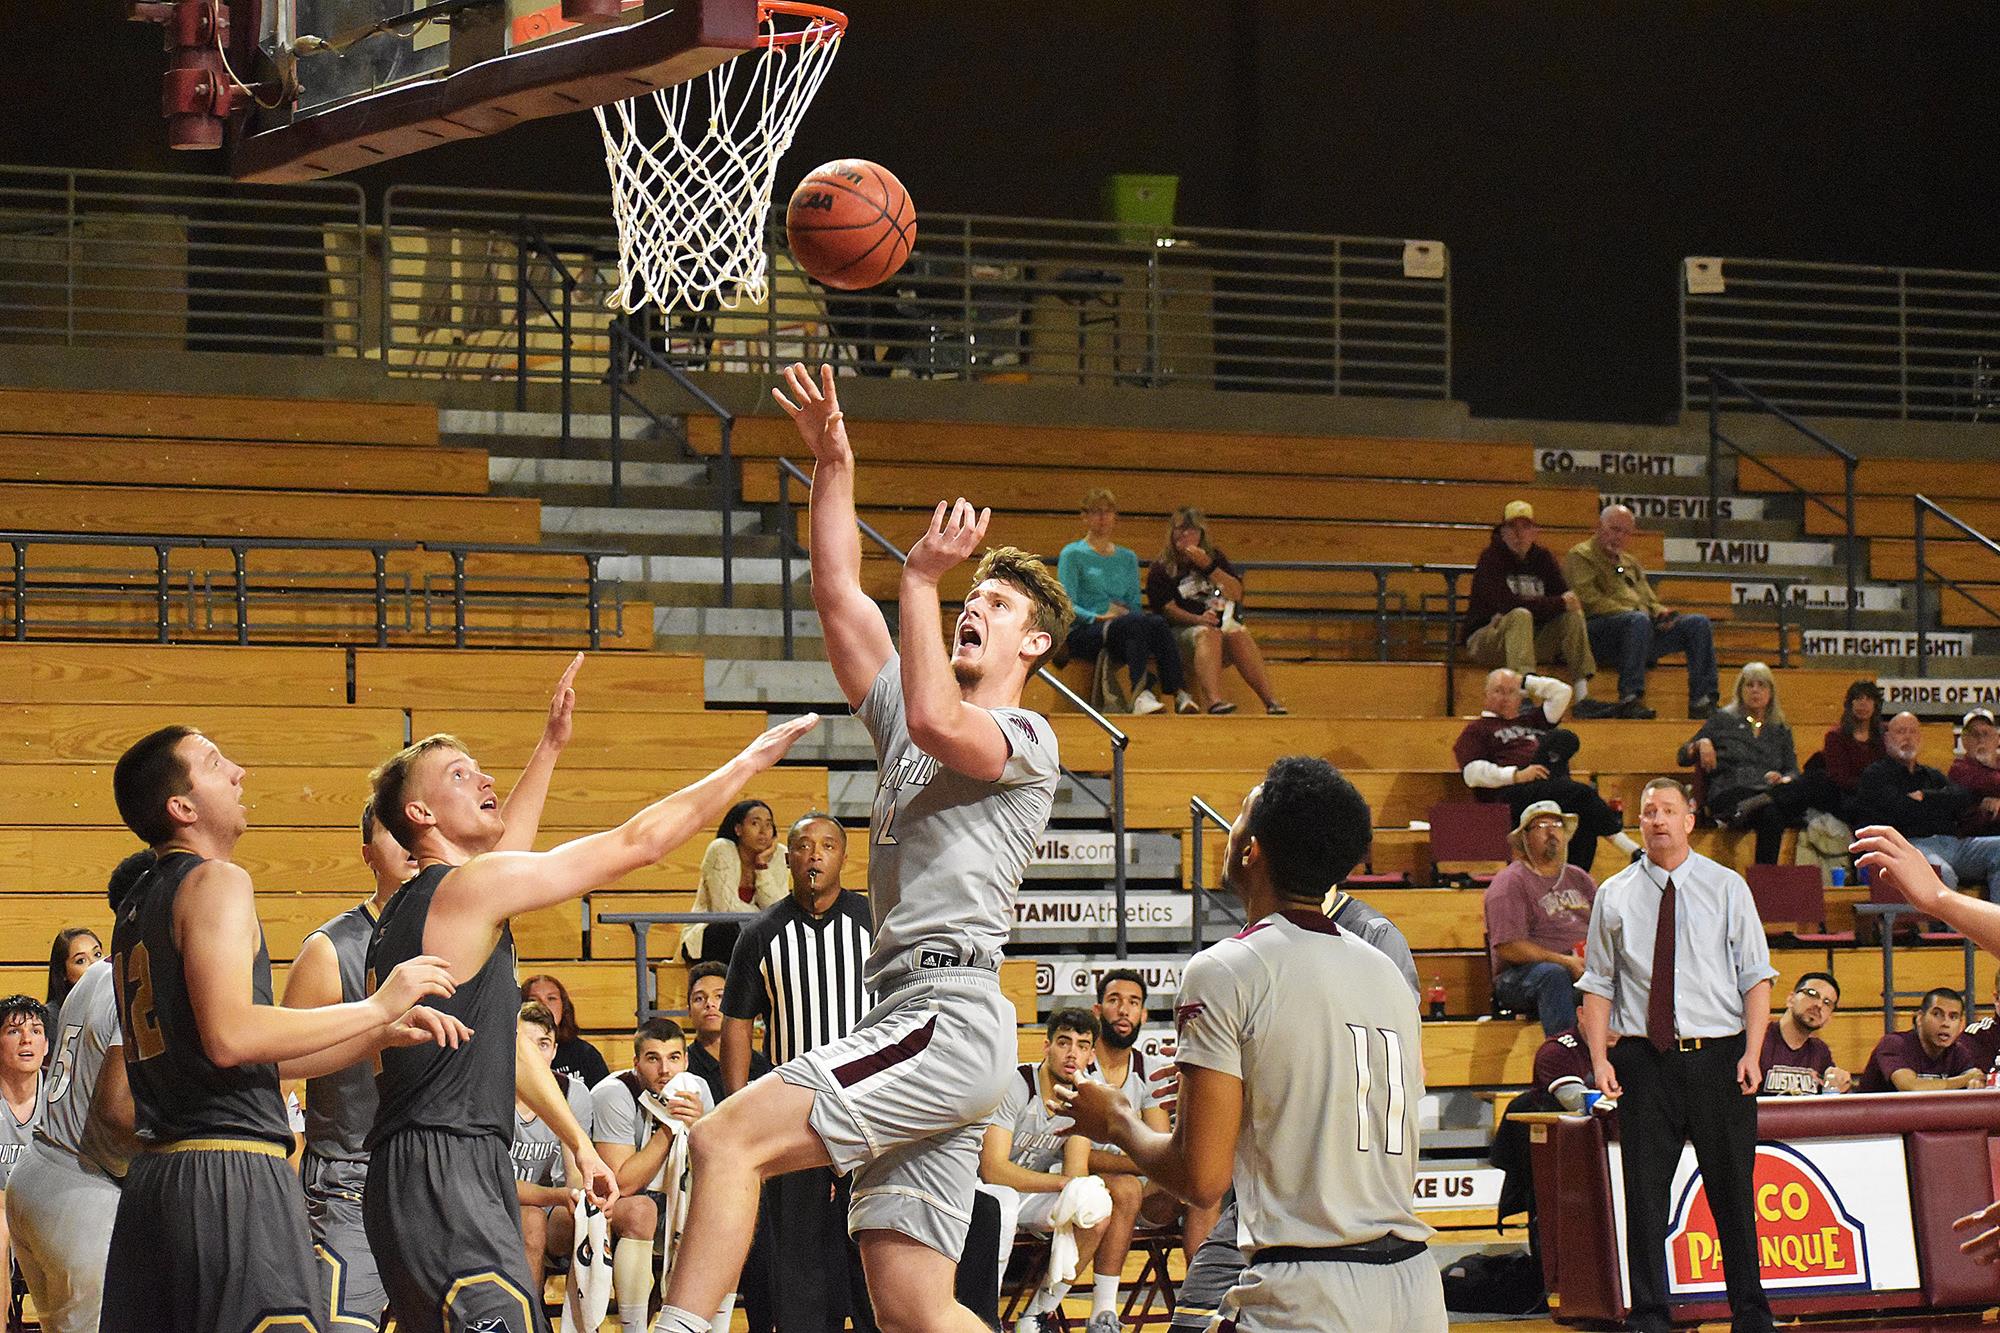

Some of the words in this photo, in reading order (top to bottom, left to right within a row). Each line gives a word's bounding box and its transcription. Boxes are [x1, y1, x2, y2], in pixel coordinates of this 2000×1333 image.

[1696, 541, 1769, 564] TAMIU
[1844, 638, 1899, 656] FIGHT!
[1906, 639, 1962, 657] FGHT!
[1890, 686, 1940, 703] PRIDE
[1946, 687, 1968, 704] OF
[1973, 686, 2000, 704] TA
[1030, 840, 1117, 860] vils.com
[1013, 903, 1174, 922] TAMIUAthetics
[1345, 1023, 1406, 1155] 11
[1444, 1176, 1474, 1198] US
[1754, 1181, 1810, 1222] CO
[1687, 1226, 1846, 1280] PANQUE
